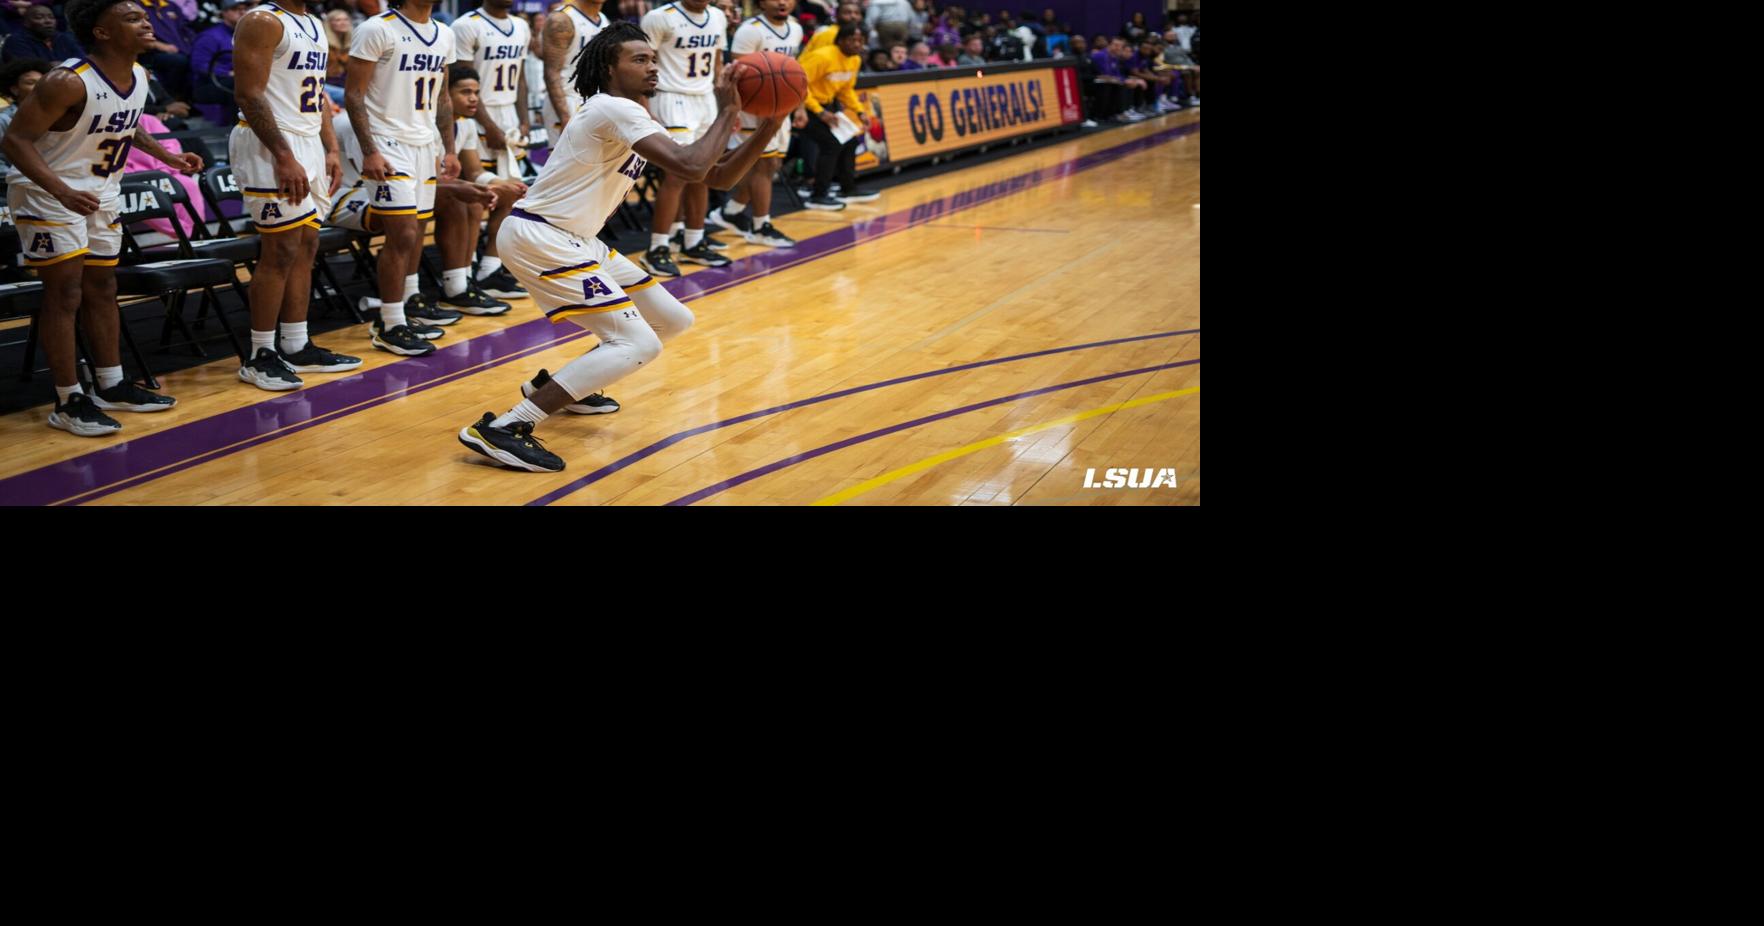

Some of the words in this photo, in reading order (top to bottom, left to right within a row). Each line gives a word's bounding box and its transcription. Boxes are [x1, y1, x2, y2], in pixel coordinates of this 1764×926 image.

[287, 51, 328, 71] LSU
[687, 51, 712, 78] 13
[494, 63, 517, 92] 10
[414, 76, 437, 111] 11
[908, 91, 945, 145] GO
[950, 79, 1046, 138] GENERALS!
[91, 135, 133, 178] 30
[216, 174, 240, 193] LS
